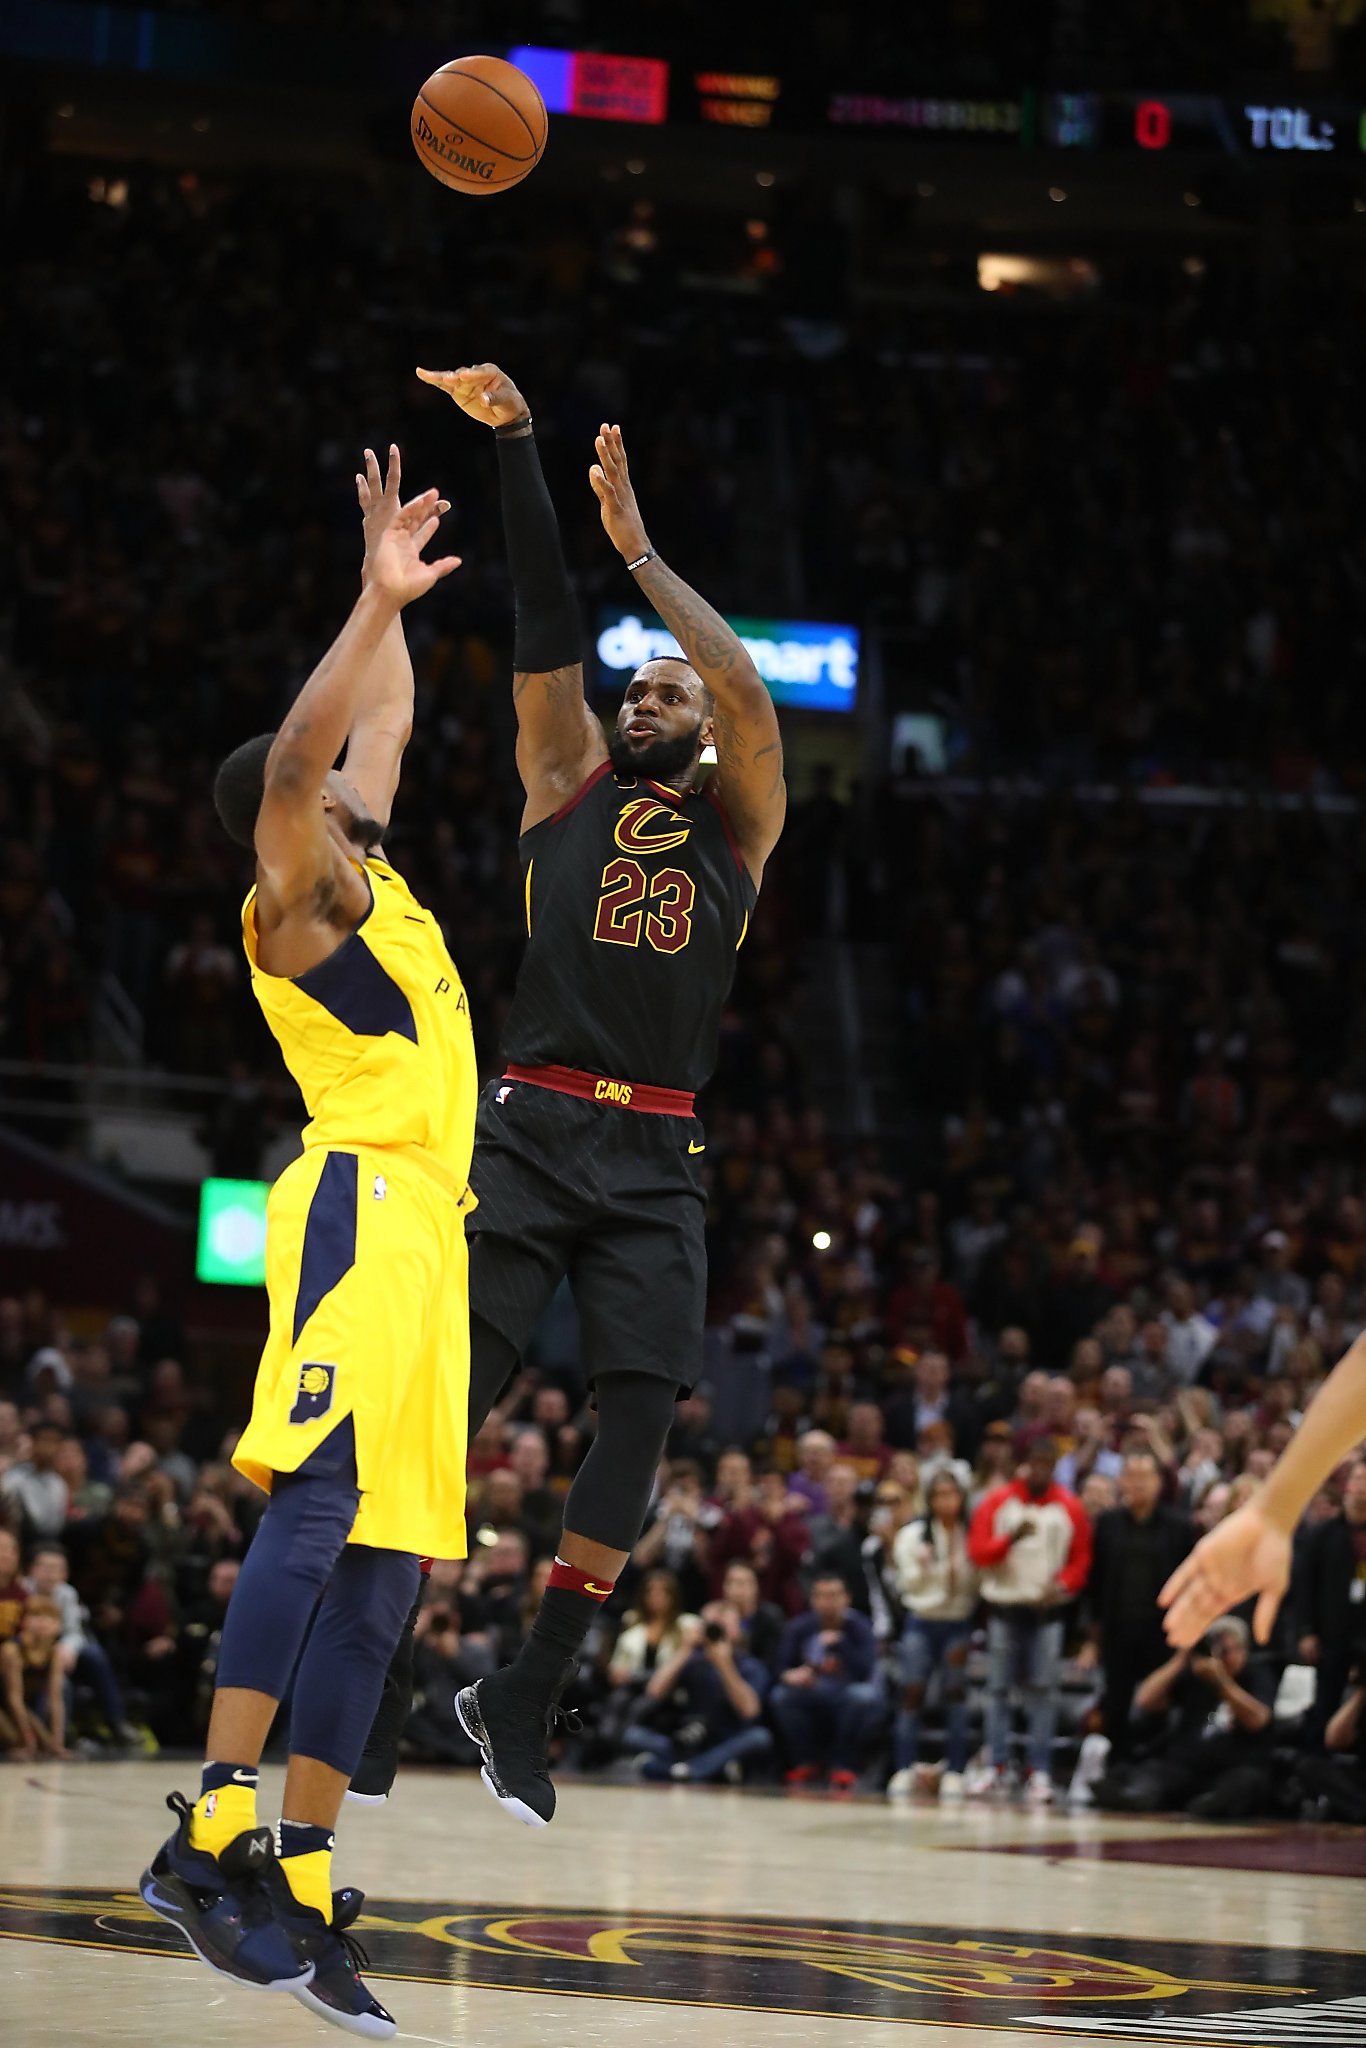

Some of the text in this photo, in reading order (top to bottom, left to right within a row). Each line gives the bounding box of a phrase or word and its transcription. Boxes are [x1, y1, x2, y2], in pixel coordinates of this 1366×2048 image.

[415, 115, 496, 179] SPALDING
[1136, 101, 1171, 150] 0
[593, 857, 696, 954] 23
[594, 1080, 633, 1105] CAVS
